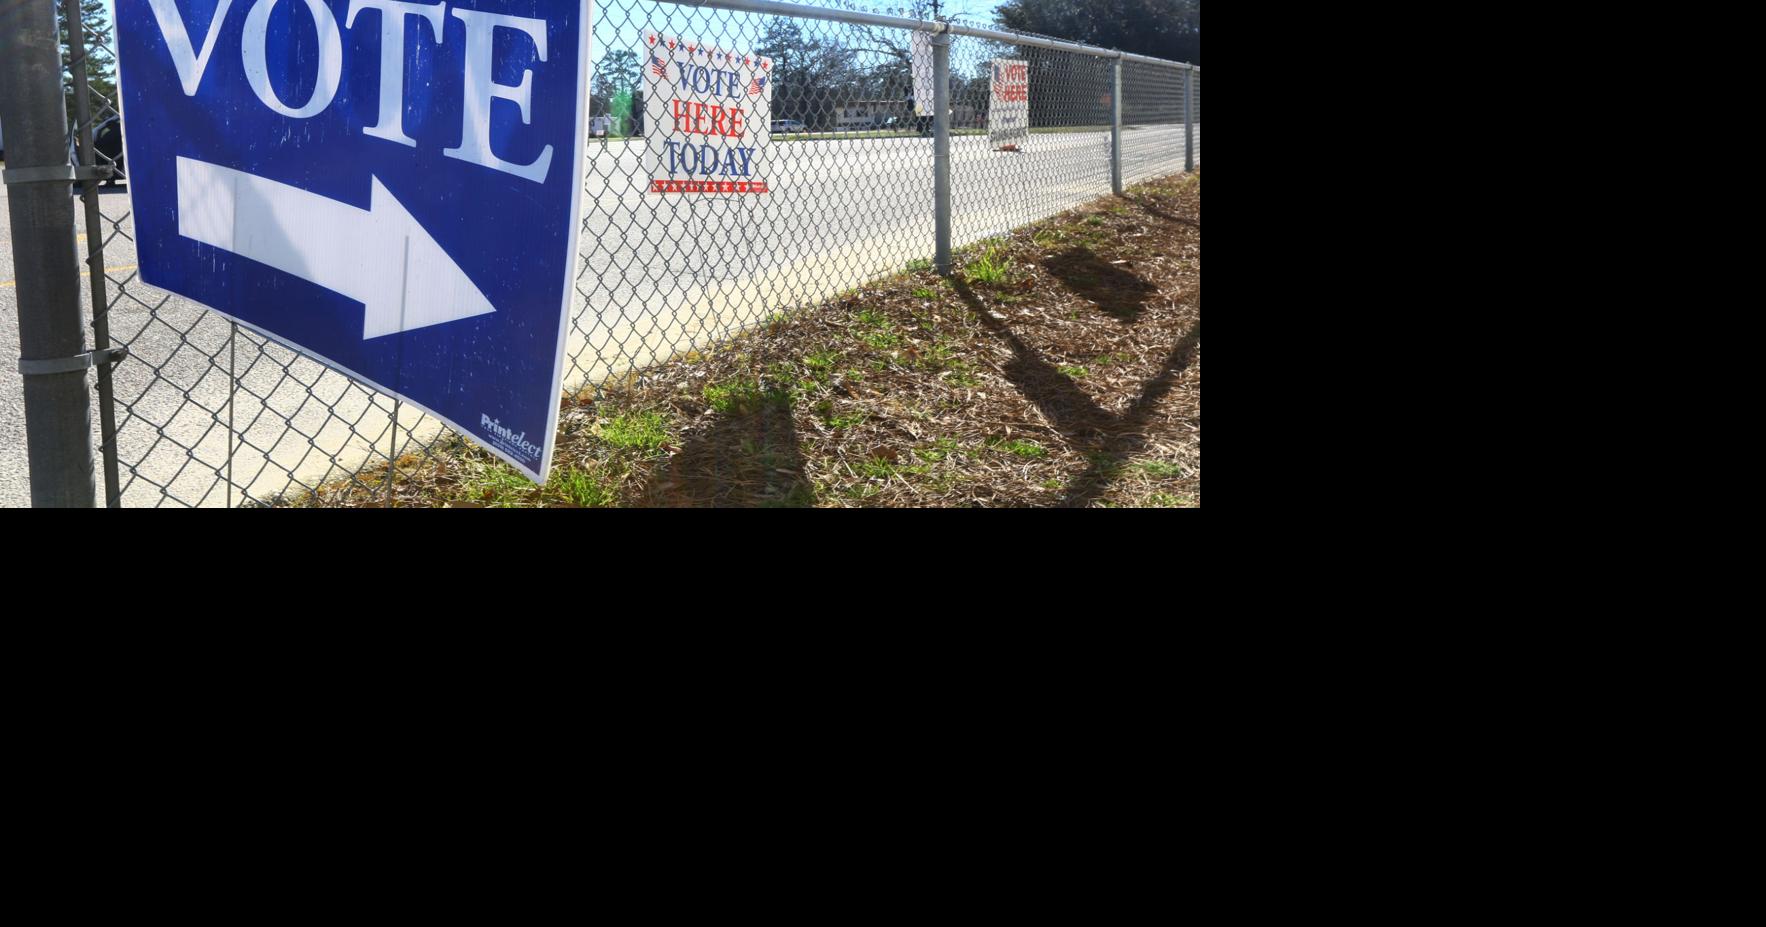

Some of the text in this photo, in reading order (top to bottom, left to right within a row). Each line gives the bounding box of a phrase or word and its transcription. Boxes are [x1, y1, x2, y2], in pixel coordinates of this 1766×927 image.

[676, 61, 741, 99] VOTE
[1004, 63, 1026, 81] VOTE
[147, 0, 554, 184] VOTE
[1003, 83, 1027, 102] HERE
[672, 99, 745, 139] HERE
[663, 140, 756, 177] TODAY
[480, 413, 542, 458] Printelect
